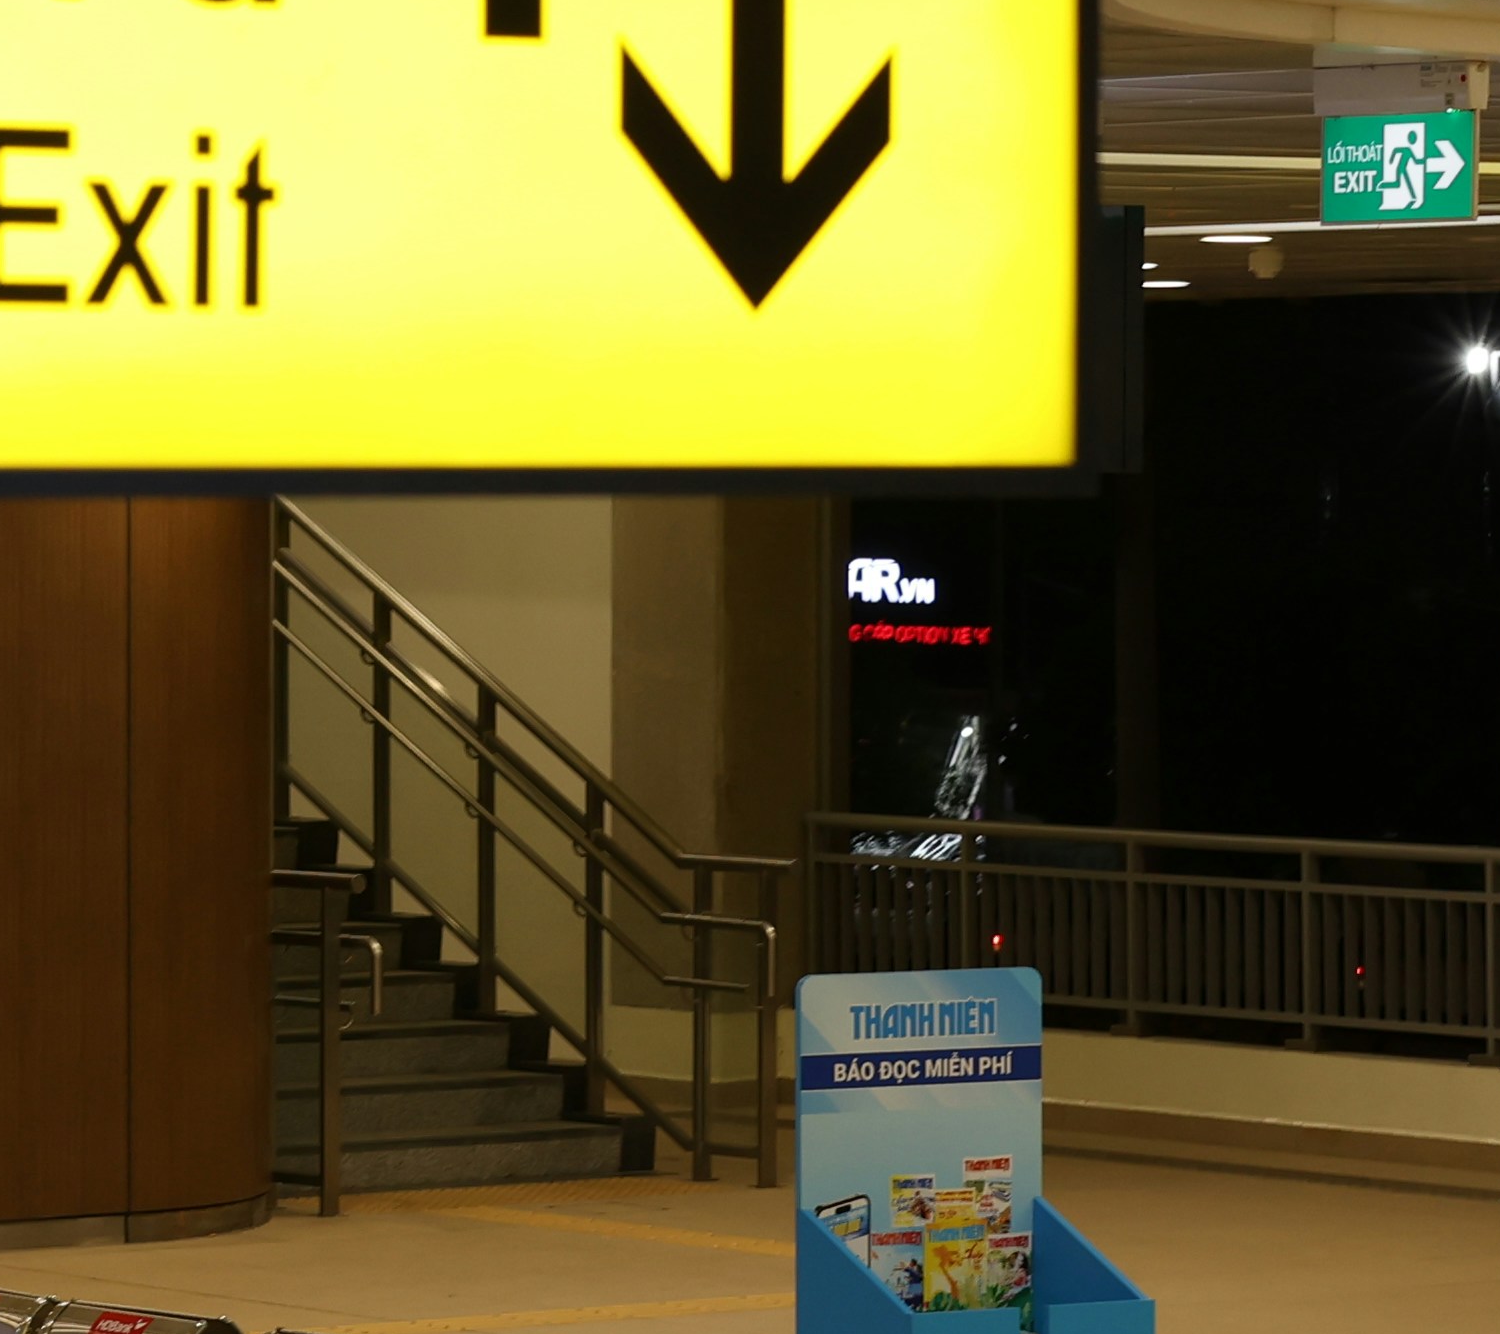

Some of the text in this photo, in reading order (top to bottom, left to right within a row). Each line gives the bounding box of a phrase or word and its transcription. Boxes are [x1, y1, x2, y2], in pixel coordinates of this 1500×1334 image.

[1328, 141, 1383, 164] LỐI THOÁT
[1334, 170, 1377, 193] EXIT
[850, 997, 996, 1040] THANH NIÊN
[834, 1051, 1013, 1084] BÁO ĐỌC MIỄN PHÍ
[99, 1318, 133, 1334] HDBank
